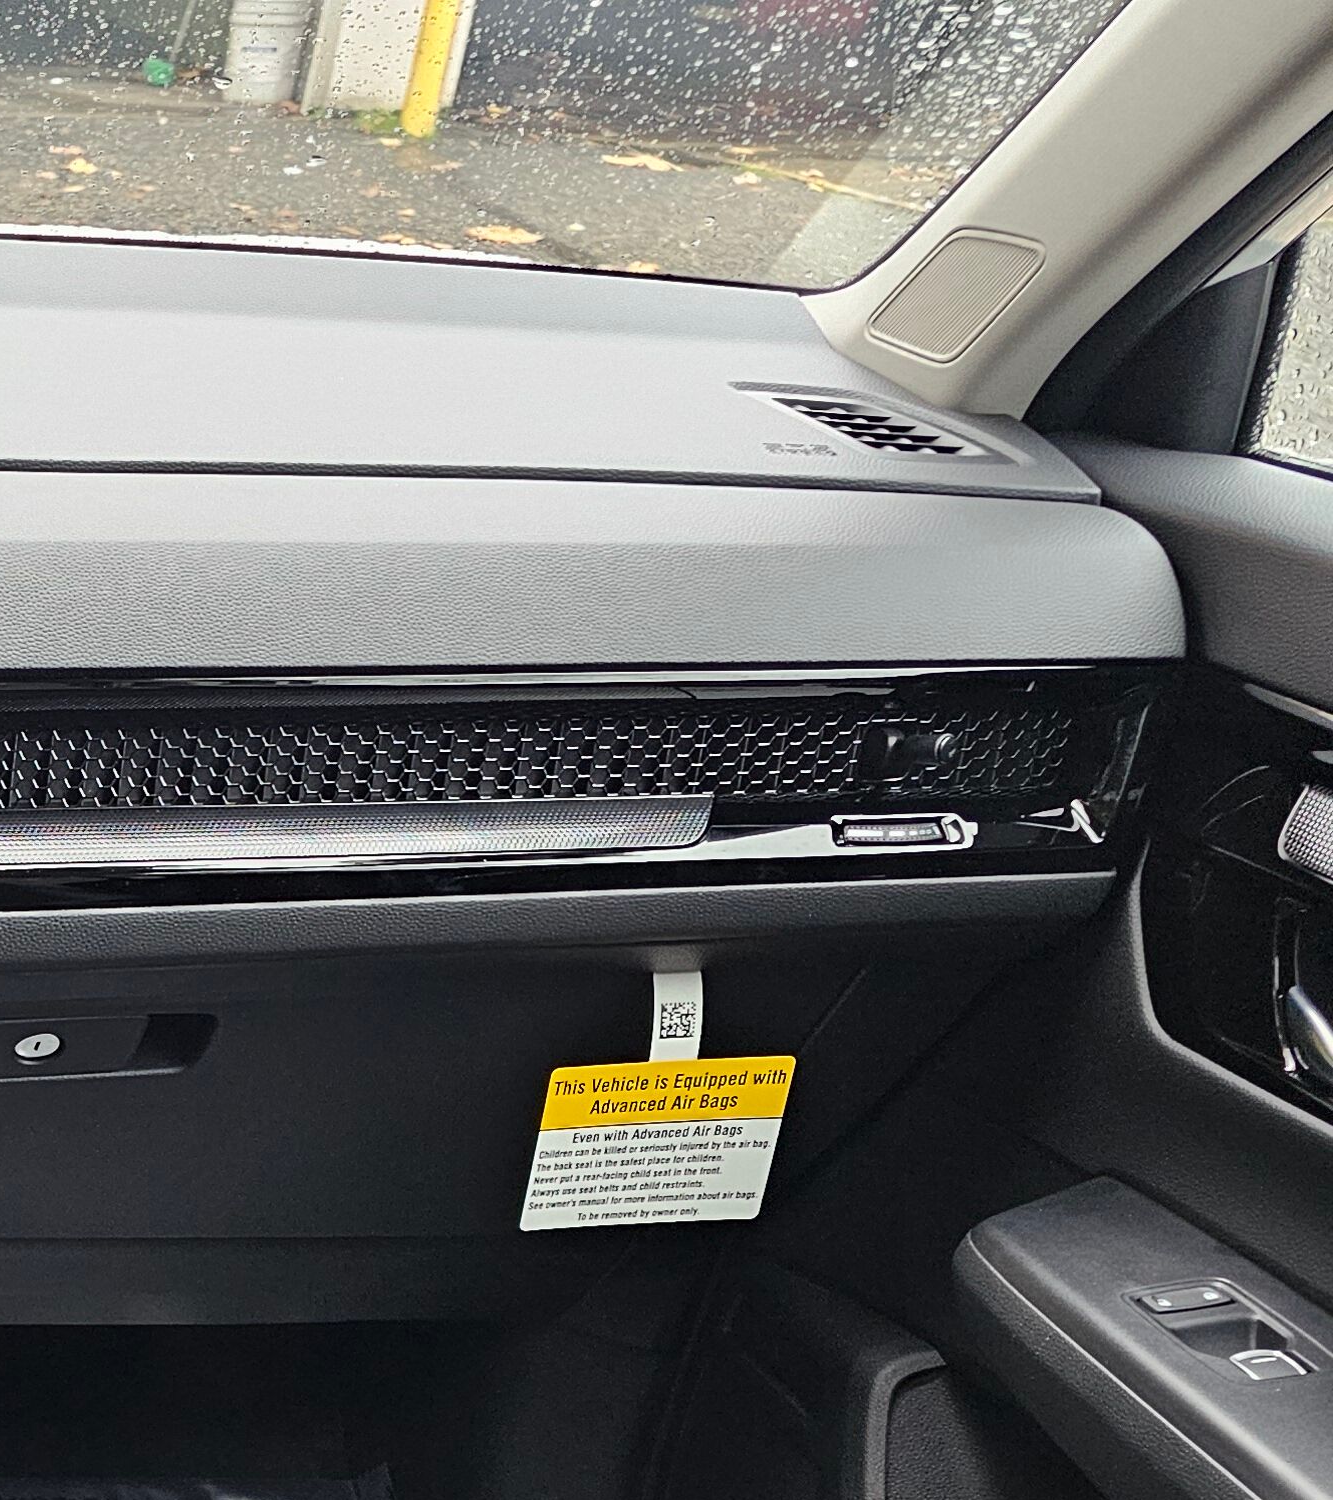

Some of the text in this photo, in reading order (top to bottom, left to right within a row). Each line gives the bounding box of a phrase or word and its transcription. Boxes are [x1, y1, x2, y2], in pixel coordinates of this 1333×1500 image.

[554, 1069, 787, 1096] This Vehicle is Equipped with
[589, 1094, 739, 1115] Advanced Air Bags
[572, 1124, 744, 1144] Even with Advanced Air Bags
[538, 1139, 771, 1160] Children can be killed or seriously injured by the air bag.
[536, 1154, 725, 1172] The back seat is the safest place for children.
[533, 1166, 723, 1185] Never put rear-facing child seat in the front.
[530, 1179, 705, 1198] Always use seat belts and child restraints.
[527, 1190, 758, 1210] See owner's manual for more information about air bags.
[577, 1206, 700, 1221] To be removed by owner only.
